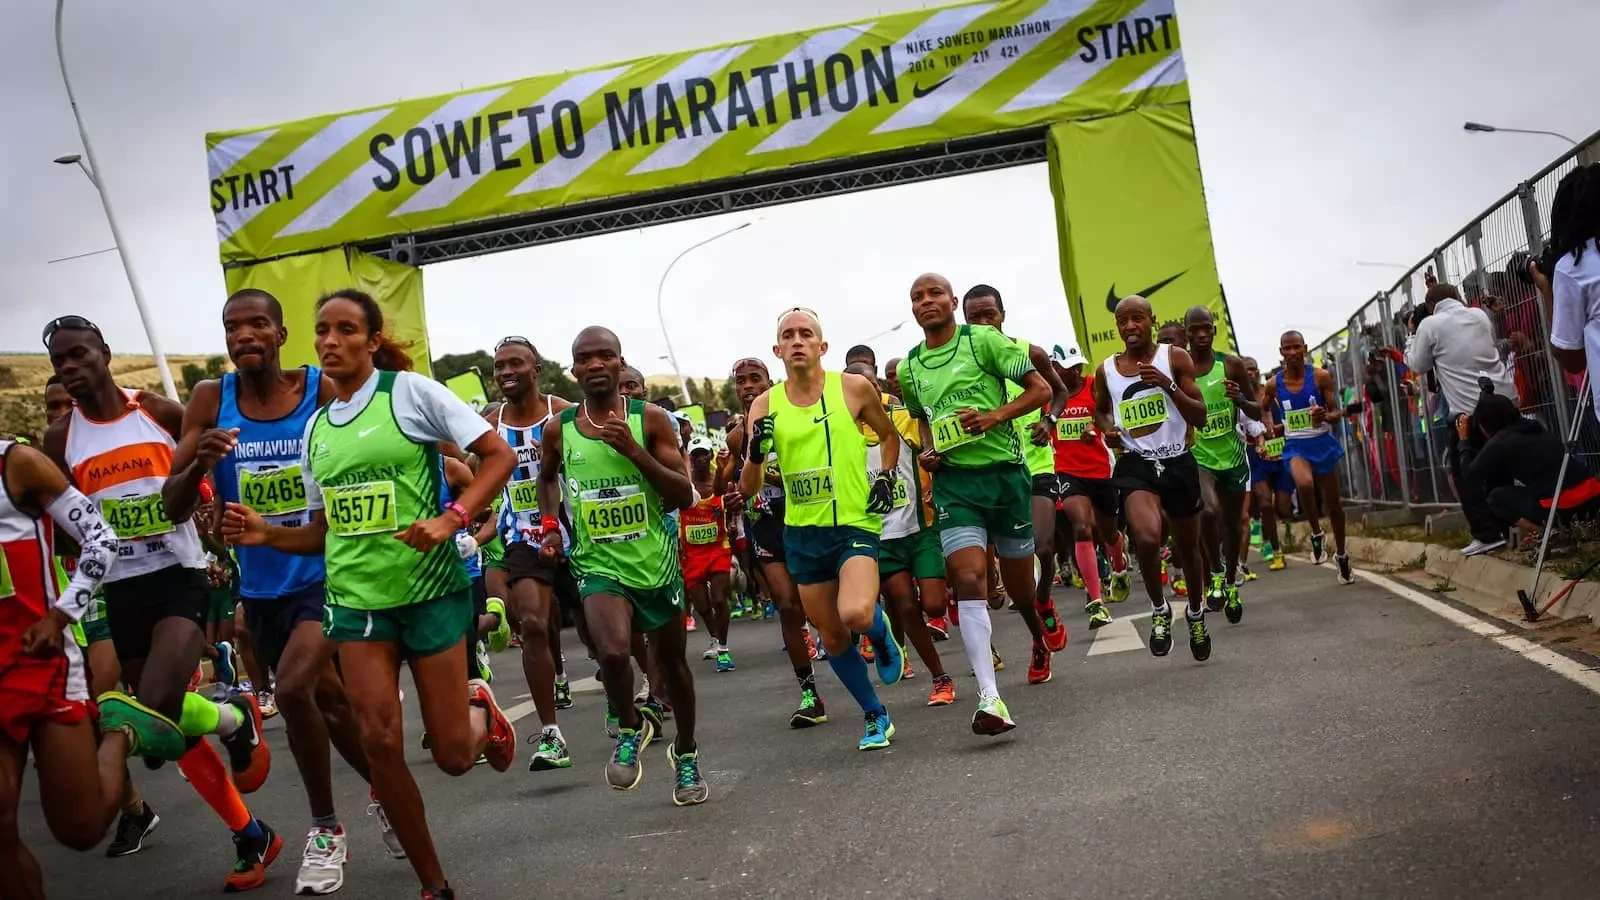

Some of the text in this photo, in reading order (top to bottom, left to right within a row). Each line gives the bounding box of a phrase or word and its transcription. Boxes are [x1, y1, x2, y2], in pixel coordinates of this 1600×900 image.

[905, 19, 1051, 55] NIKE SOWETO MARATHON
[1078, 14, 1174, 64] START
[908, 59, 935, 73] 2014
[369, 45, 900, 193] SOWETO MARATHON
[210, 164, 296, 214] START
[1091, 330, 1116, 343] NIKE
[934, 380, 989, 412] NEDBANK
[1124, 399, 1166, 422] 41088
[1060, 422, 1088, 435] 4048
[89, 458, 153, 480] MAKANA
[244, 475, 306, 505] 42465
[580, 473, 642, 491] NEDBAN
[791, 475, 832, 498] 40374
[331, 494, 389, 524] 45577
[588, 503, 645, 530] 43600
[690, 527, 717, 541] 40293
